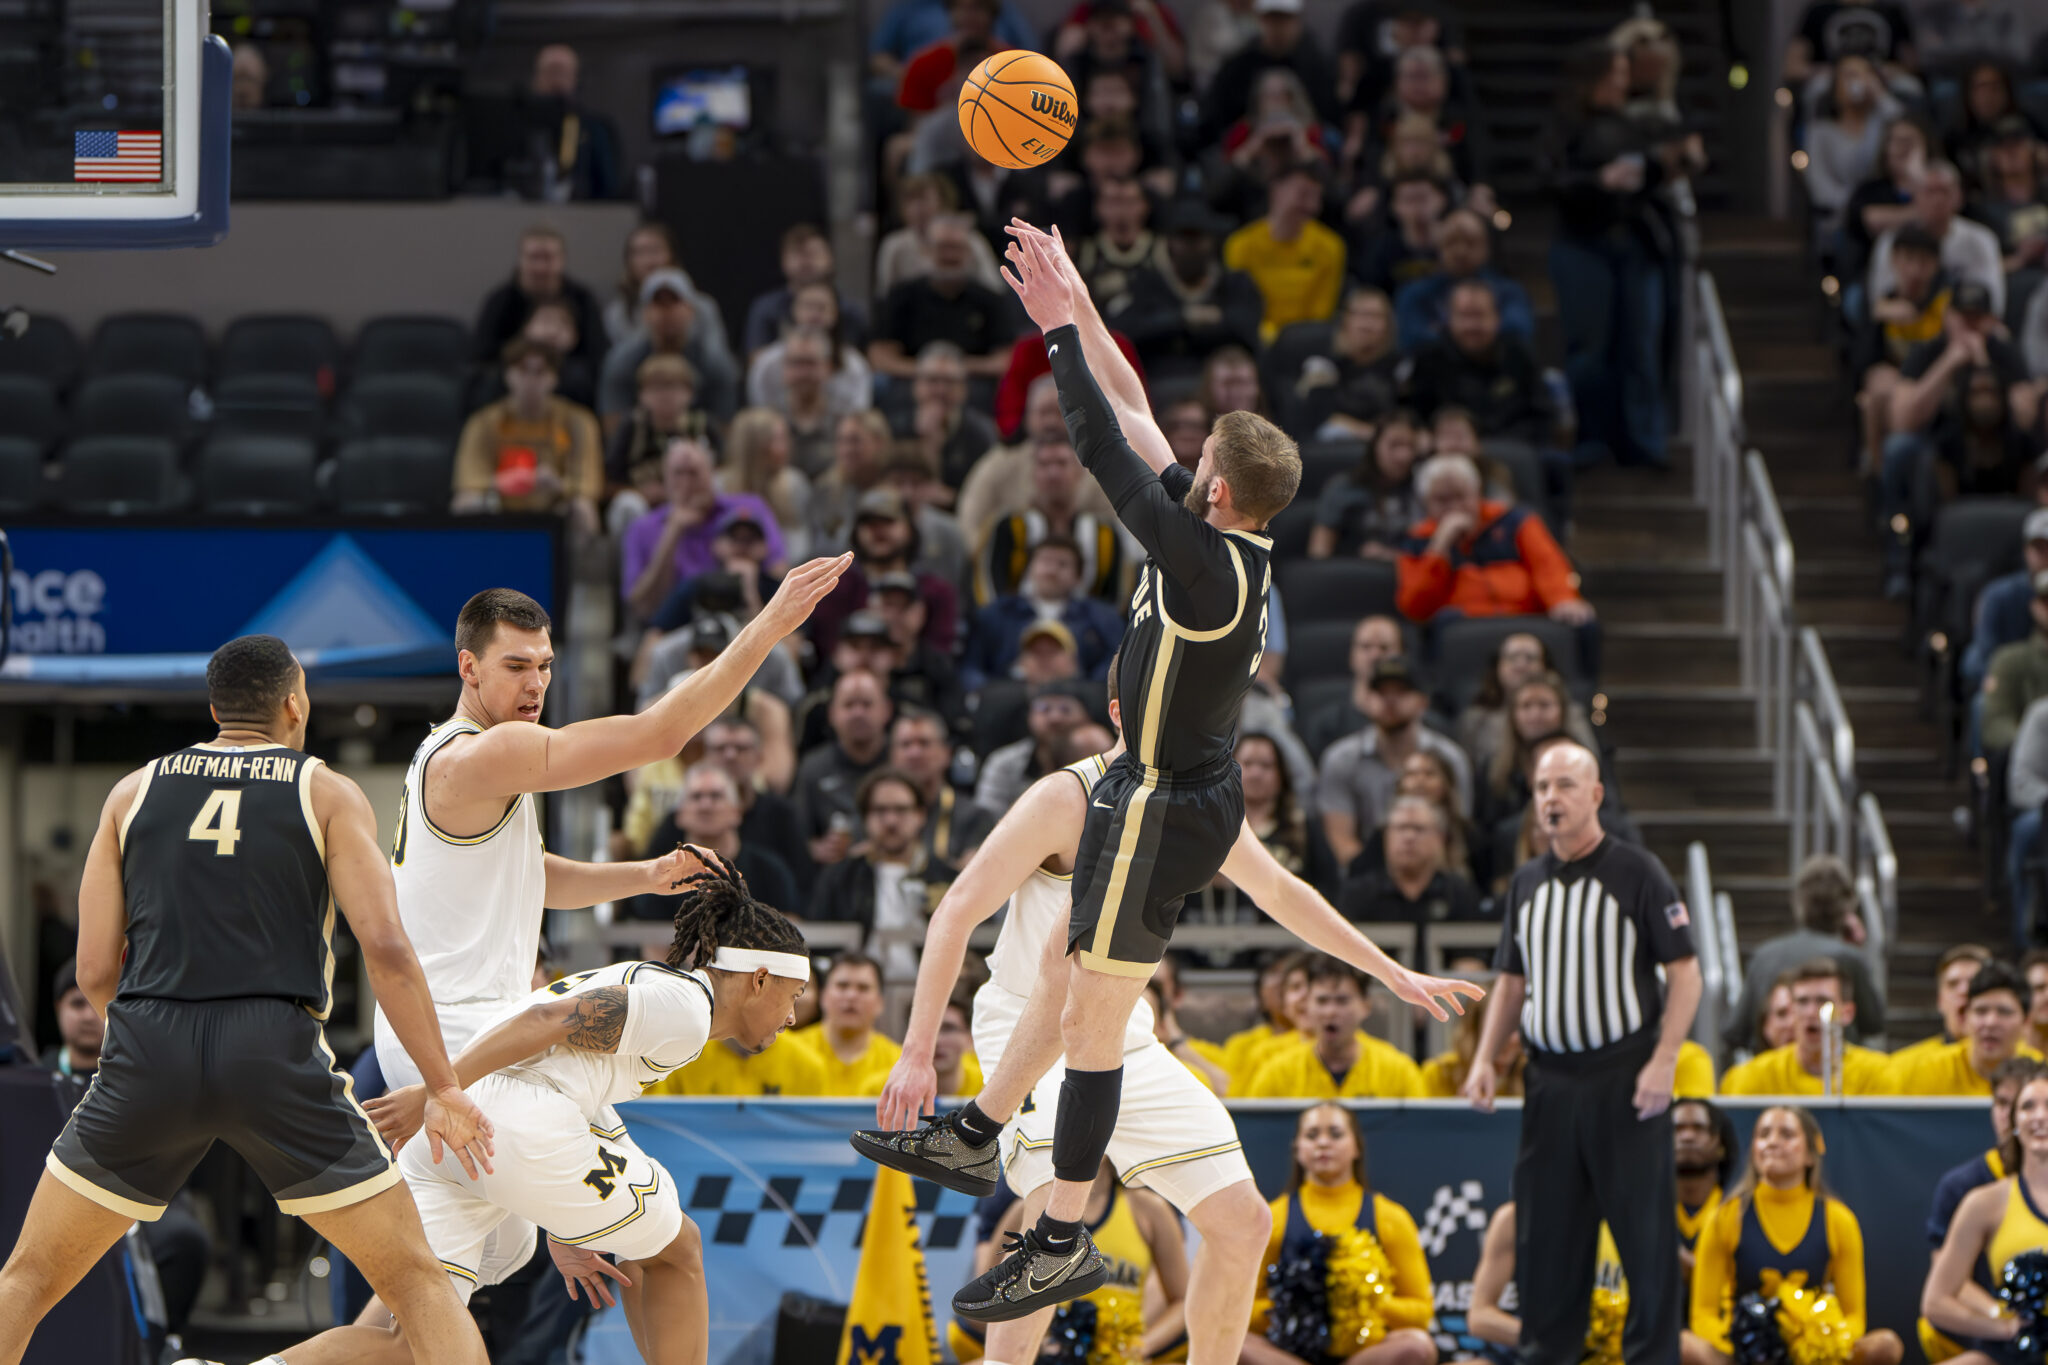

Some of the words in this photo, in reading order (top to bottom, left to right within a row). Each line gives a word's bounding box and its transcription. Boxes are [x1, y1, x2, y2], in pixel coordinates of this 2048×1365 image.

[158, 753, 298, 783] KAUFMAN-RENN
[187, 788, 243, 857] 4
[582, 1144, 628, 1202] M
[848, 1324, 905, 1365] M
